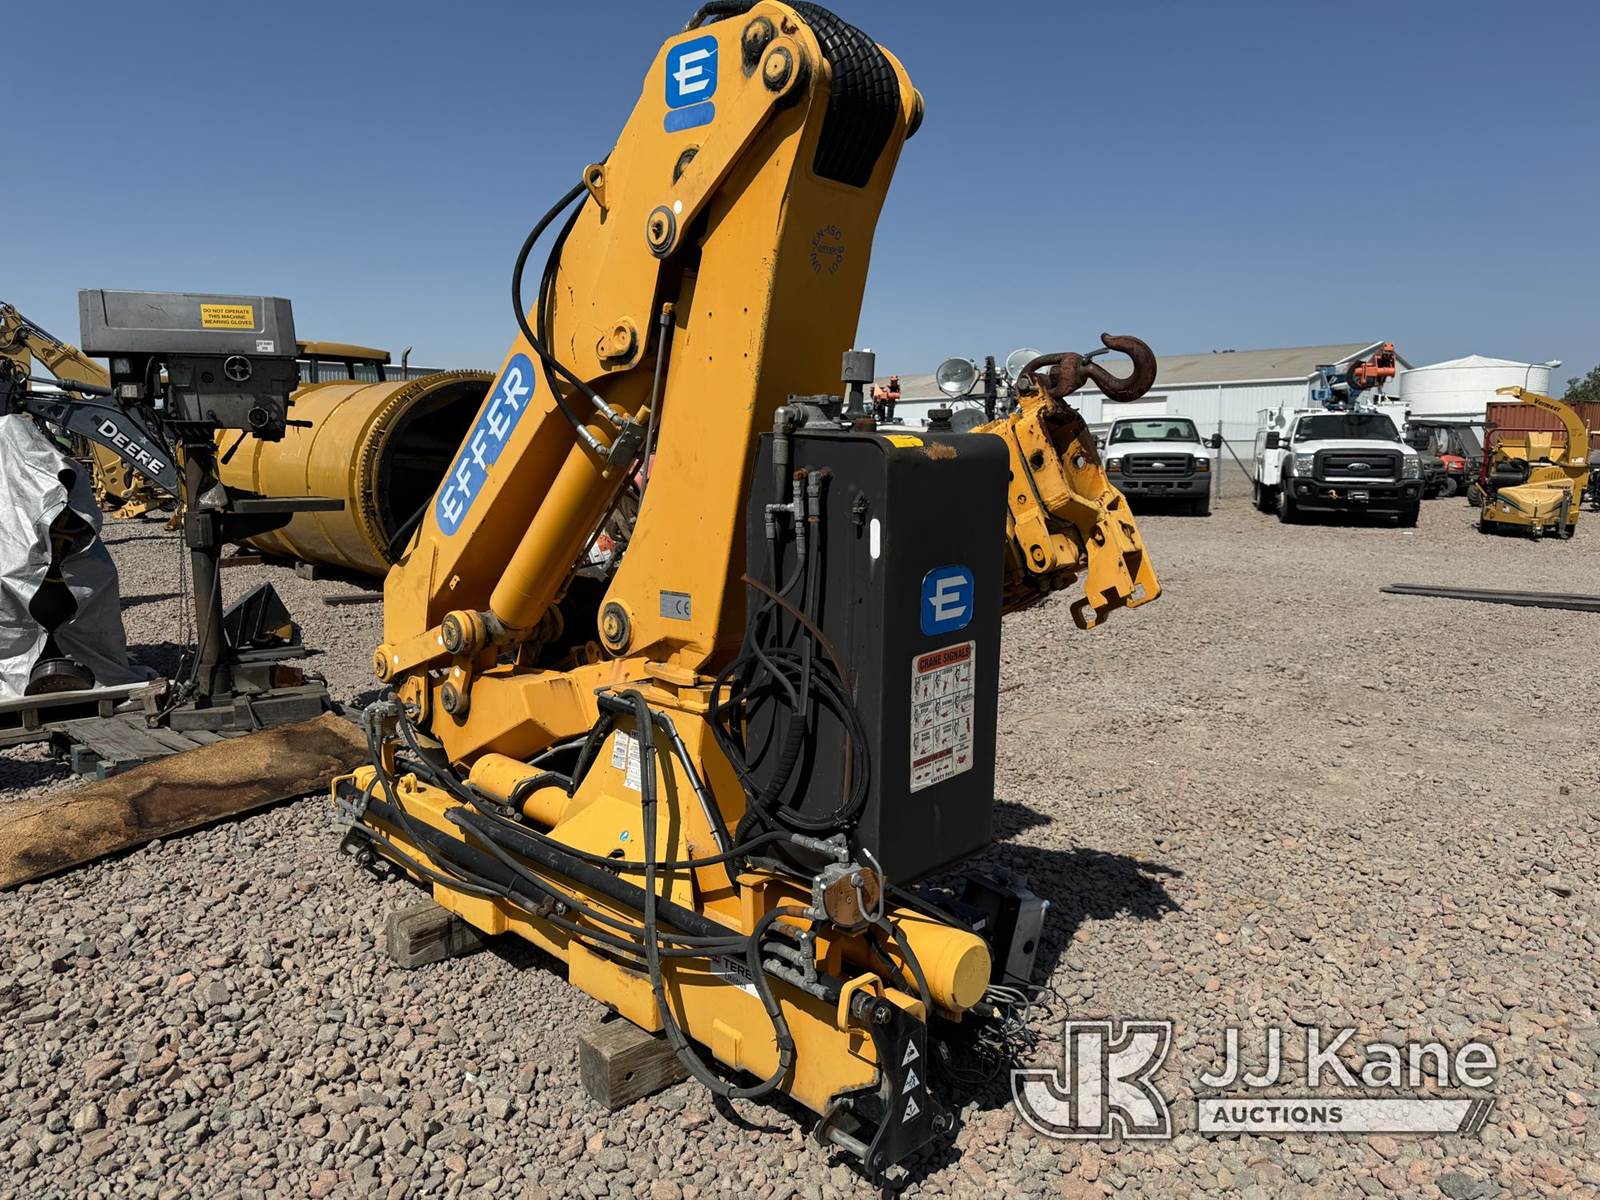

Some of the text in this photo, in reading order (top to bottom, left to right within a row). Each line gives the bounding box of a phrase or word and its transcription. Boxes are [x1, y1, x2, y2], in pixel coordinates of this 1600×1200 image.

[1533, 397, 1562, 413] Vermeer
[97, 419, 165, 474] DEERE
[441, 367, 529, 525] EFFER
[920, 646, 970, 670] CRANE SIGNALS
[723, 957, 753, 981] TERE
